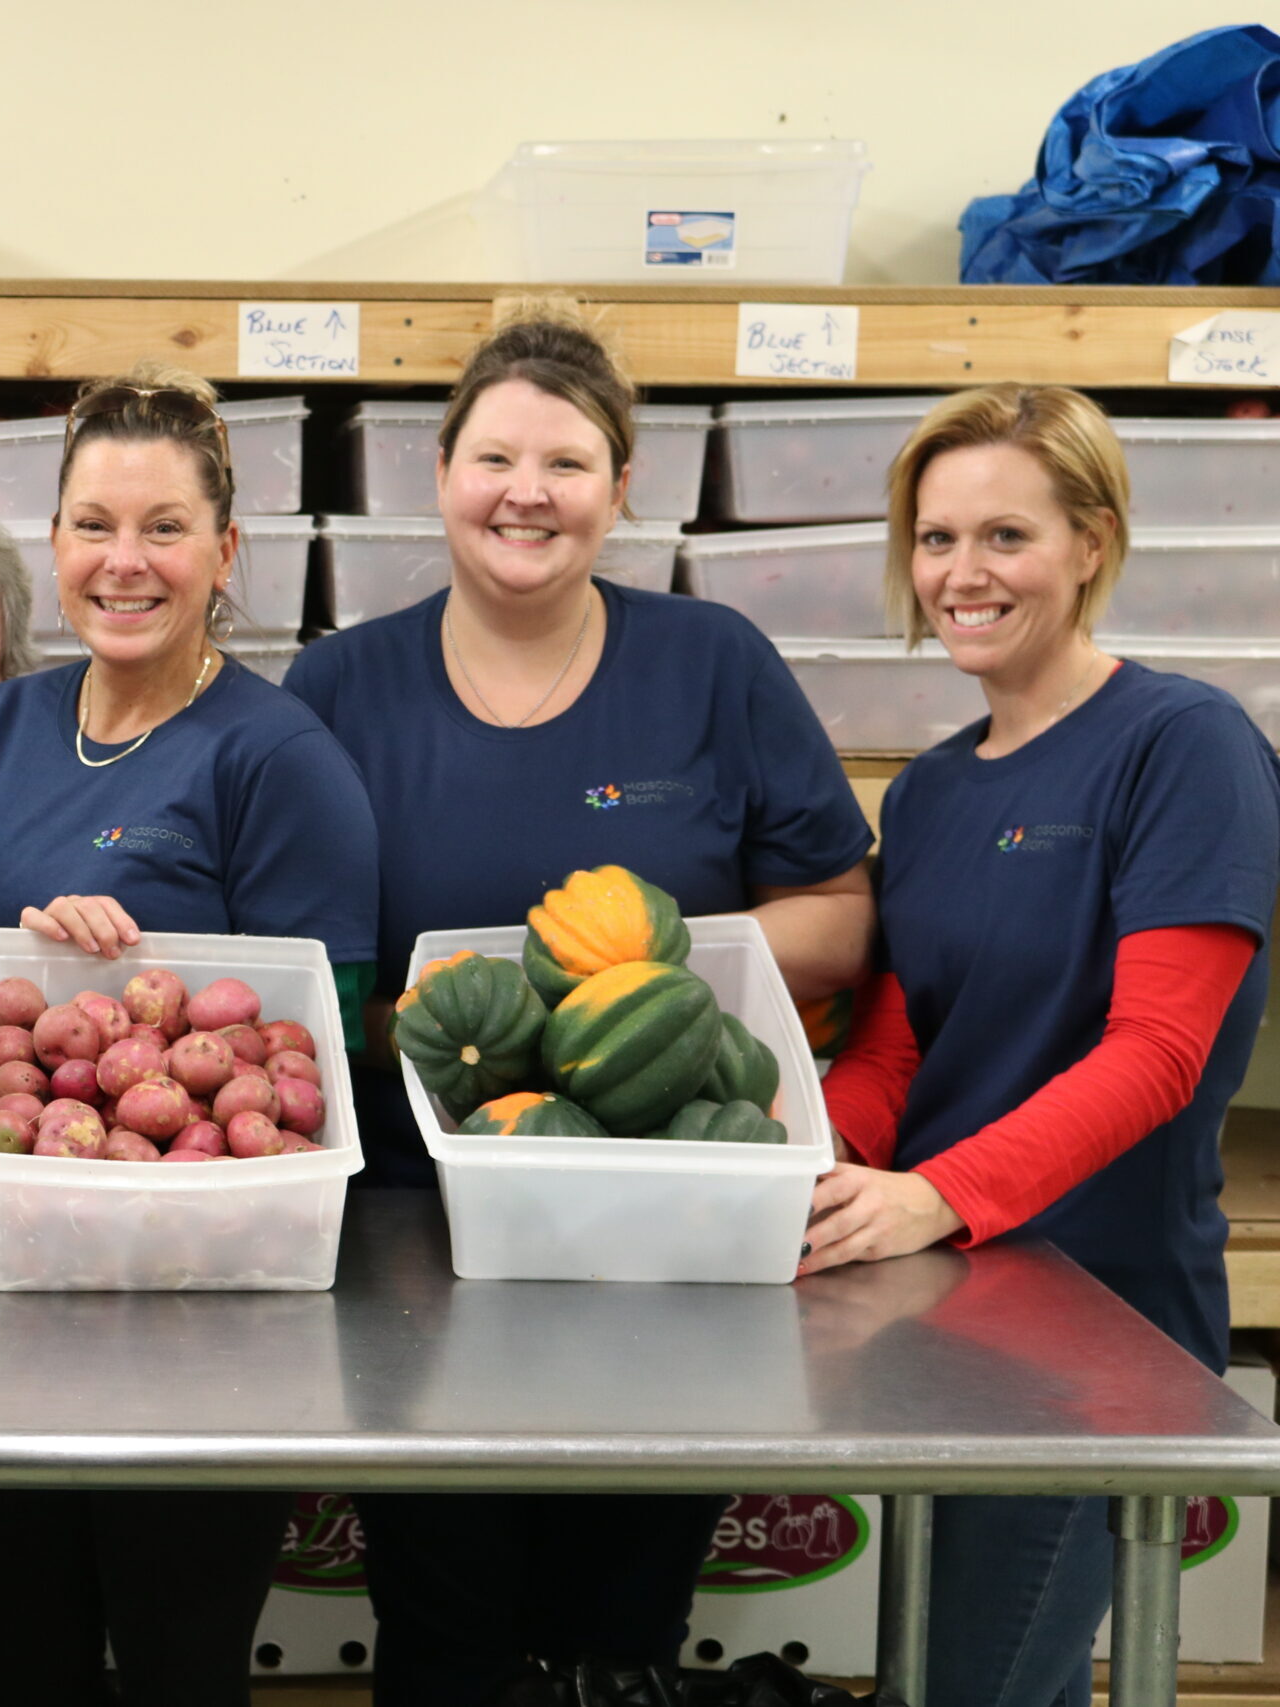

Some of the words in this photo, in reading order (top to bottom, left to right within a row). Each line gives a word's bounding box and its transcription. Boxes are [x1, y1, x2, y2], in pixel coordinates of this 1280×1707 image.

[247, 310, 308, 335] BLUE
[747, 320, 807, 350] BLUE
[265, 339, 355, 371] SECTION
[769, 353, 852, 378] SECTION
[625, 791, 665, 805] Bank
[119, 837, 153, 852] Bank
[125, 826, 194, 849] Mascoma
